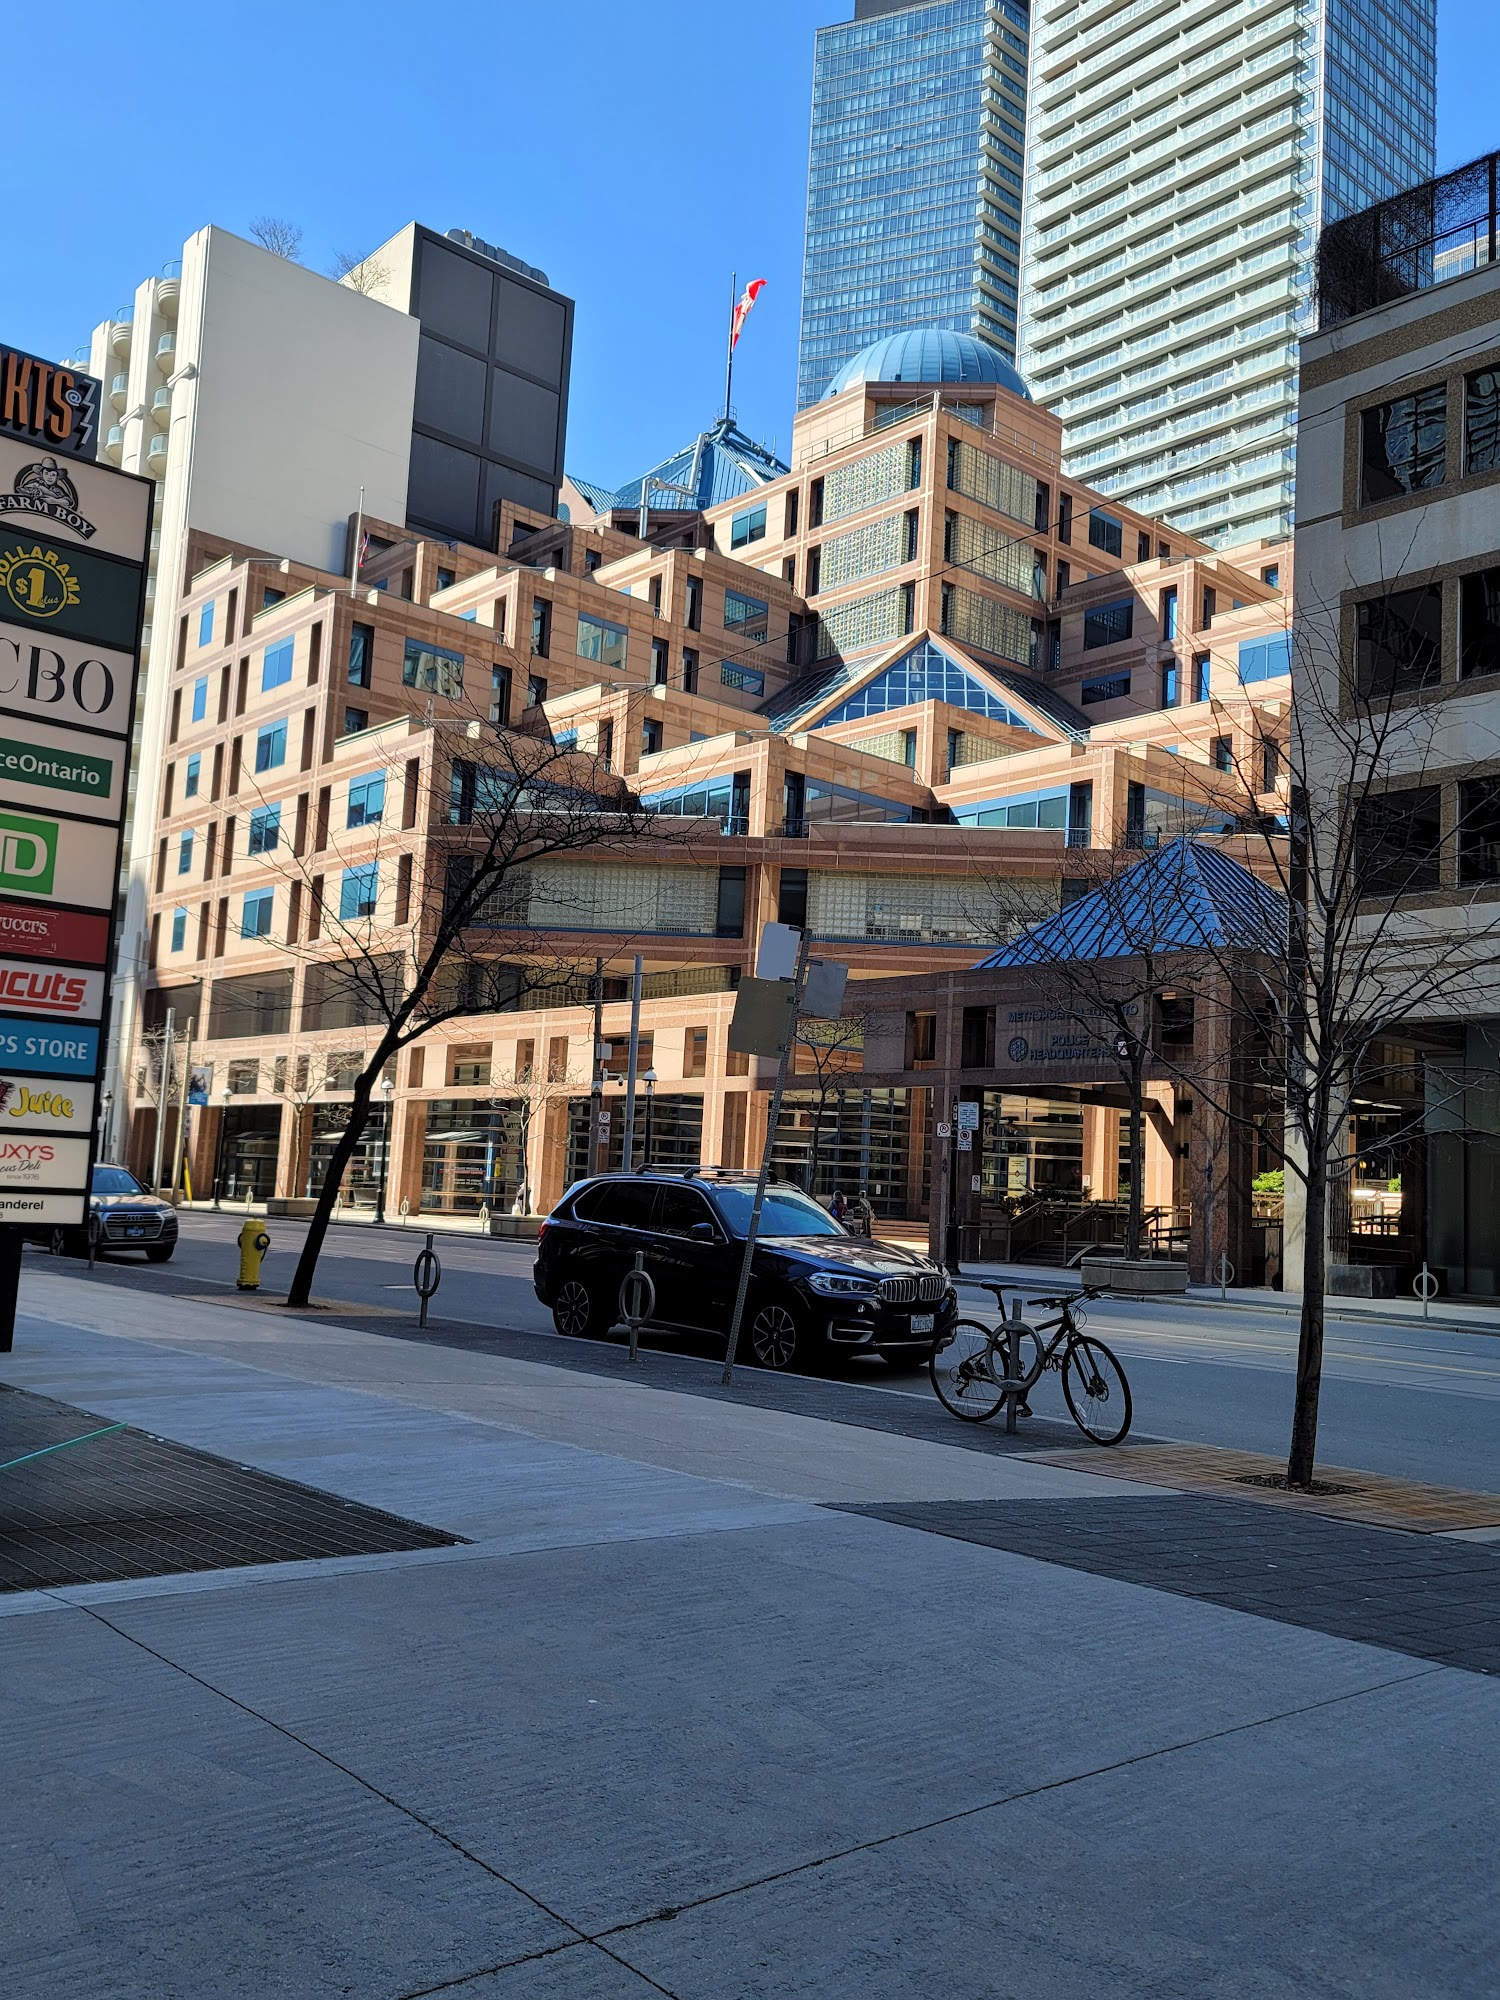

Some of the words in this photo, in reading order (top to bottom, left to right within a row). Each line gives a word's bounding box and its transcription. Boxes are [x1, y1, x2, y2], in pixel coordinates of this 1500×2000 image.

[4, 352, 75, 439] KTS
[0, 495, 50, 514] FARM
[53, 505, 94, 534] BOY
[0, 546, 81, 605] DOLLARAMA
[15, 567, 46, 608] $1
[0, 827, 48, 878] D
[1008, 1009, 1084, 1023] METROPOLN
[1087, 1004, 1138, 1018] TOTO
[25, 1037, 88, 1060] STORE
[1030, 1046, 1112, 1060] HEADQUARTERS
[1051, 1034, 1089, 1047] POLICE
[9, 1087, 73, 1118] Juice
[18, 1159, 42, 1172] Deli
[22, 1173, 40, 1181] 1976
